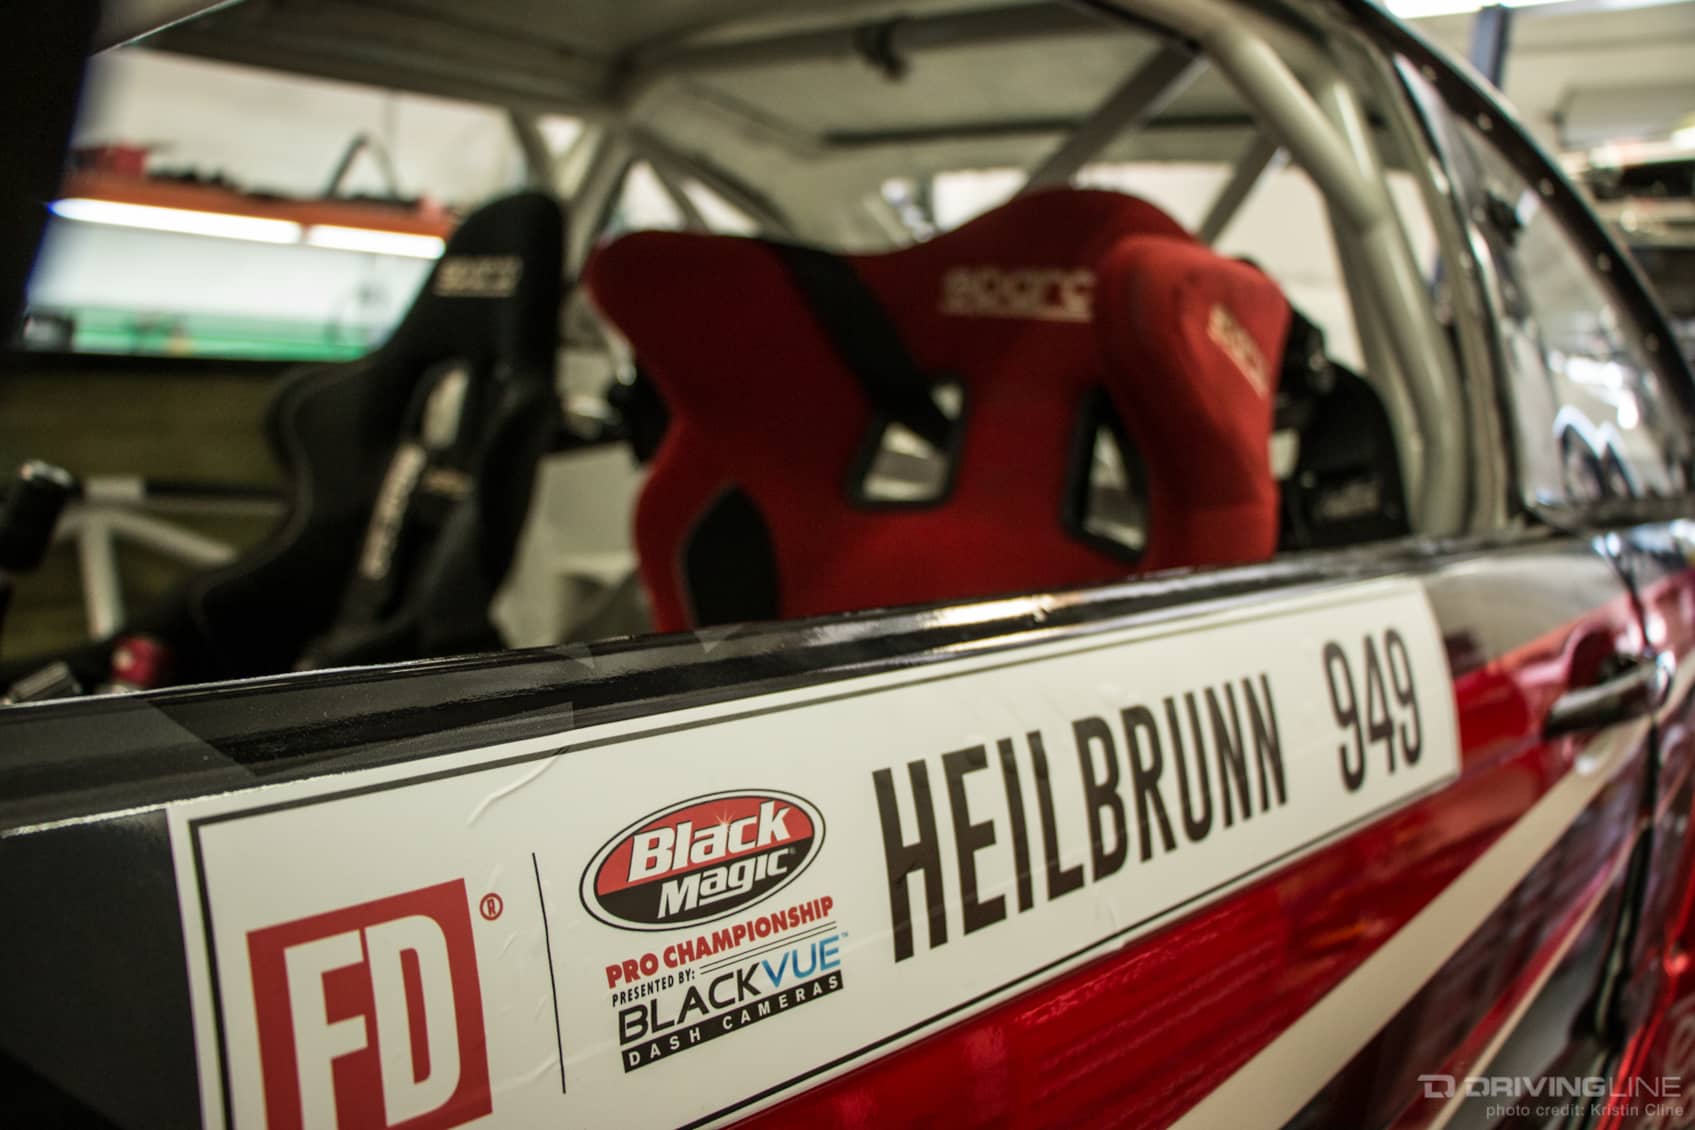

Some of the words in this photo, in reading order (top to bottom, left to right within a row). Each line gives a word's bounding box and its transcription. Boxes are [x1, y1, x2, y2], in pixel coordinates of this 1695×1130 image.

[627, 800, 791, 883] Black
[872, 673, 1288, 963] HEILBRUNN
[1323, 628, 1423, 792] 949
[657, 848, 789, 919] Magic
[605, 953, 659, 989] PRO
[663, 896, 834, 968] CHAMPIONSHIP
[612, 974, 674, 1008] PRESENTED
[678, 968, 695, 984] BY:
[283, 914, 461, 1130] FD
[629, 1027, 701, 1067] DASH
[722, 975, 839, 1030] CAMERAS
